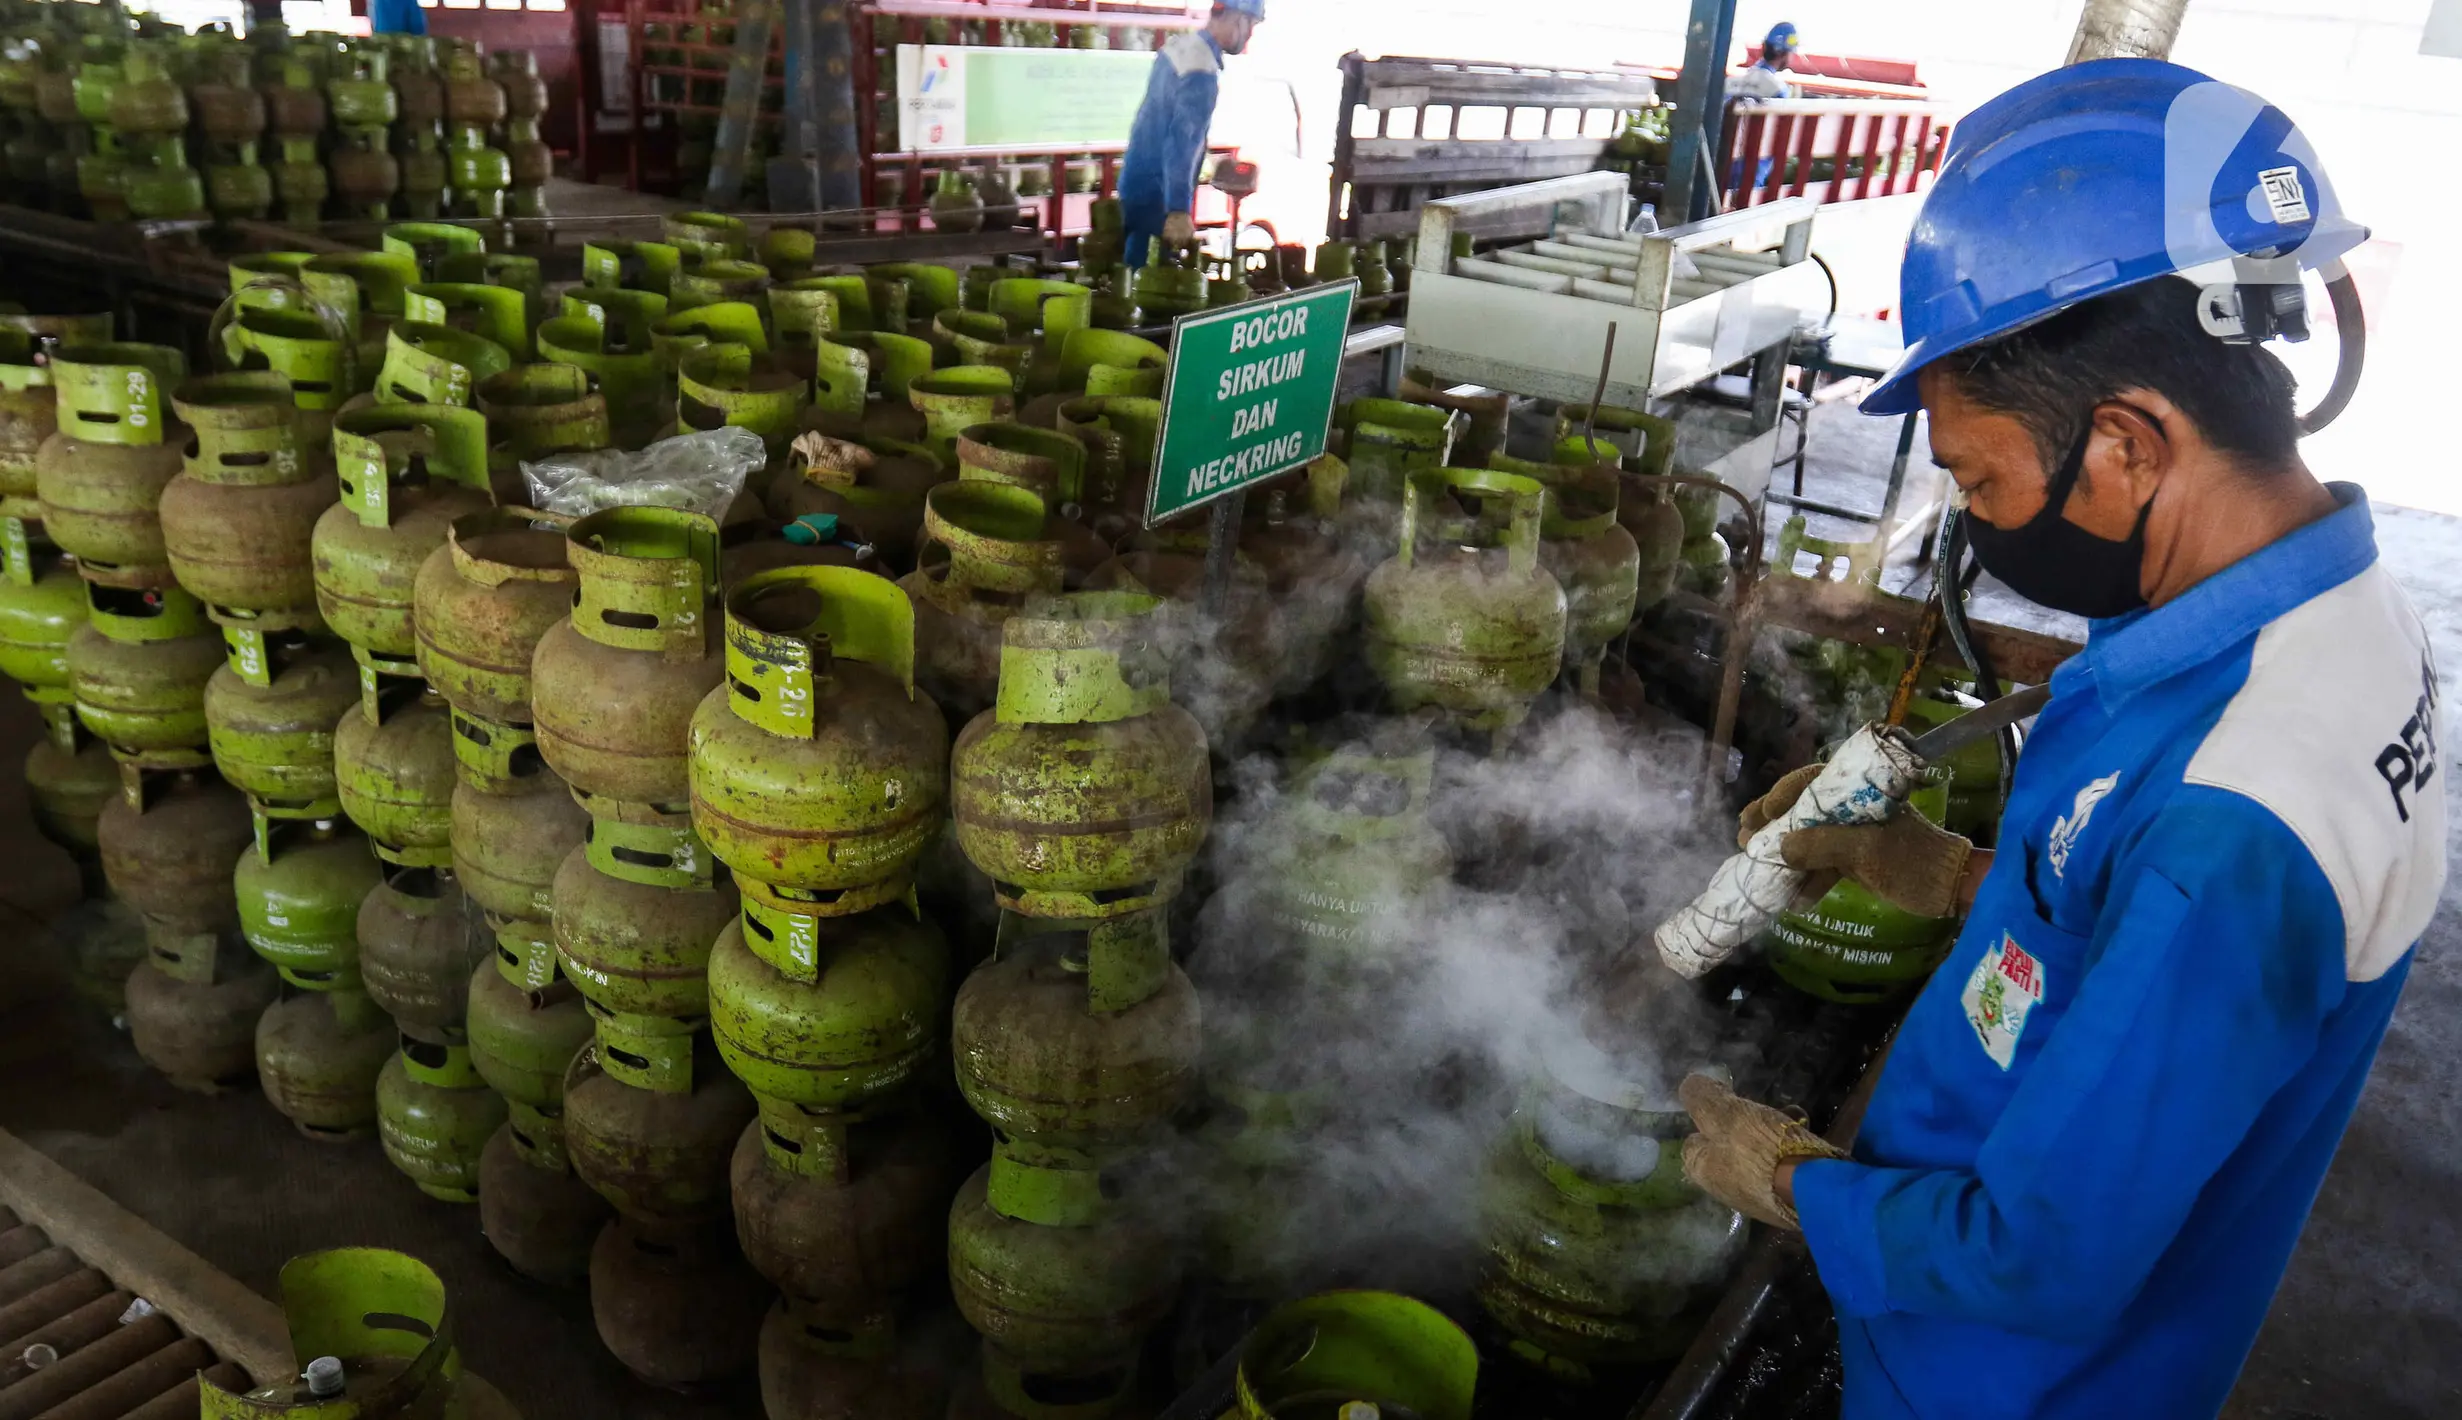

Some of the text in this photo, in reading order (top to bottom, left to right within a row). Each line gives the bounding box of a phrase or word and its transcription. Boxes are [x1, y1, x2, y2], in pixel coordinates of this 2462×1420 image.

[1229, 306, 1309, 353] BOCOR
[1217, 348, 1306, 401] SIRKUM
[127, 371, 148, 427] 01-29
[1230, 399, 1278, 440] DAN
[1186, 431, 1303, 497] NECKRING
[1297, 887, 1346, 913] HANYA
[1824, 916, 1875, 938] UNTUK
[1842, 947, 1893, 966] MISKIN
